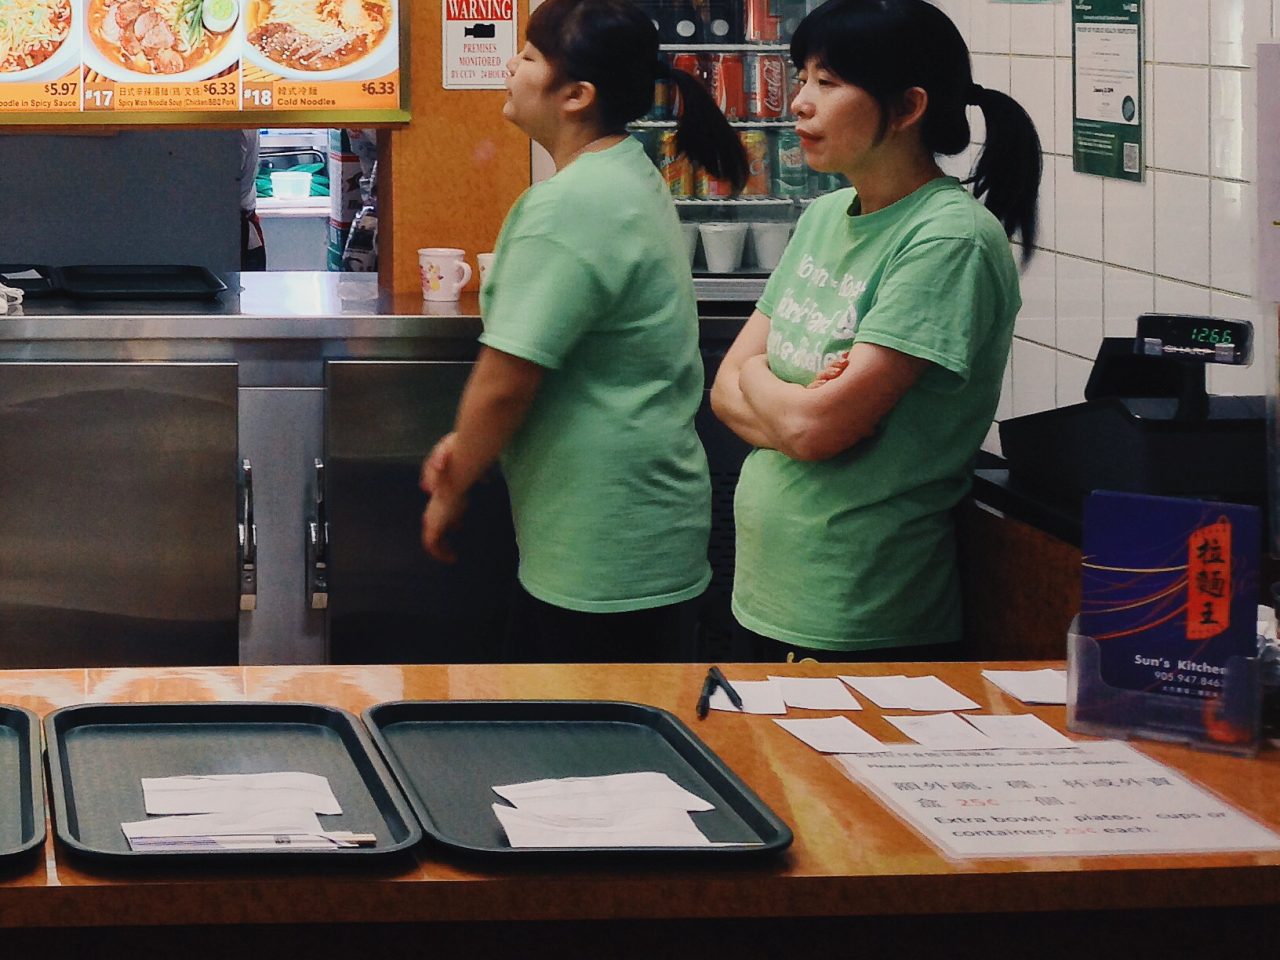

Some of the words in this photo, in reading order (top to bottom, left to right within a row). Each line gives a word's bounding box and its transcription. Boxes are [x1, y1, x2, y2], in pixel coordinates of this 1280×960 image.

[448, 0, 511, 19] WARNING
[464, 43, 497, 53] PREMISES
[459, 57, 501, 66] MONITORED
[44, 83, 77, 96] $5.97
[204, 83, 236, 95] $6.33
[361, 82, 395, 95] $6.33
[85, 90, 113, 107] #17
[244, 89, 272, 106] #18
[31, 100, 51, 108] Spicy
[1135, 655, 1170, 668] Sun's
[1155, 671, 1173, 681] 905
[1177, 674, 1197, 683] 947
[934, 816, 987, 827] Extra
[952, 828, 1057, 838] containers
